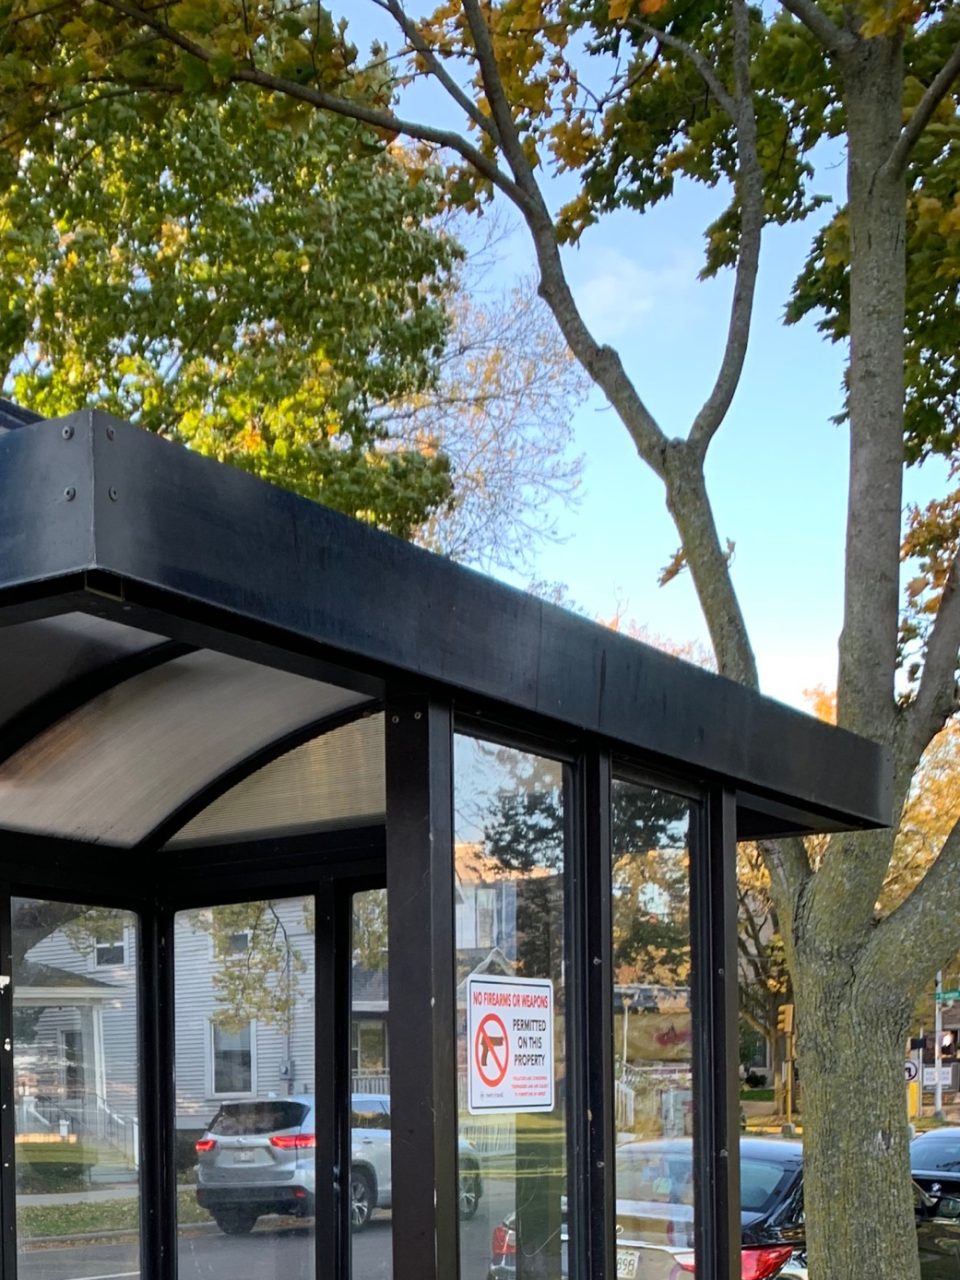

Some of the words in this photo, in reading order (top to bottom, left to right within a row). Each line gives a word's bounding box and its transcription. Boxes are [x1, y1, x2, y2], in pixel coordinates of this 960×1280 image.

[473, 991, 483, 1005] NO
[484, 992, 511, 1007] FIREARMS
[512, 993, 521, 1007] OR
[522, 994, 548, 1008] WEAPONS
[513, 1019, 546, 1031] PERMITTED
[517, 1036, 527, 1049] ON
[529, 1037, 542, 1049] THIS
[514, 1054, 545, 1066] PROPERTY
